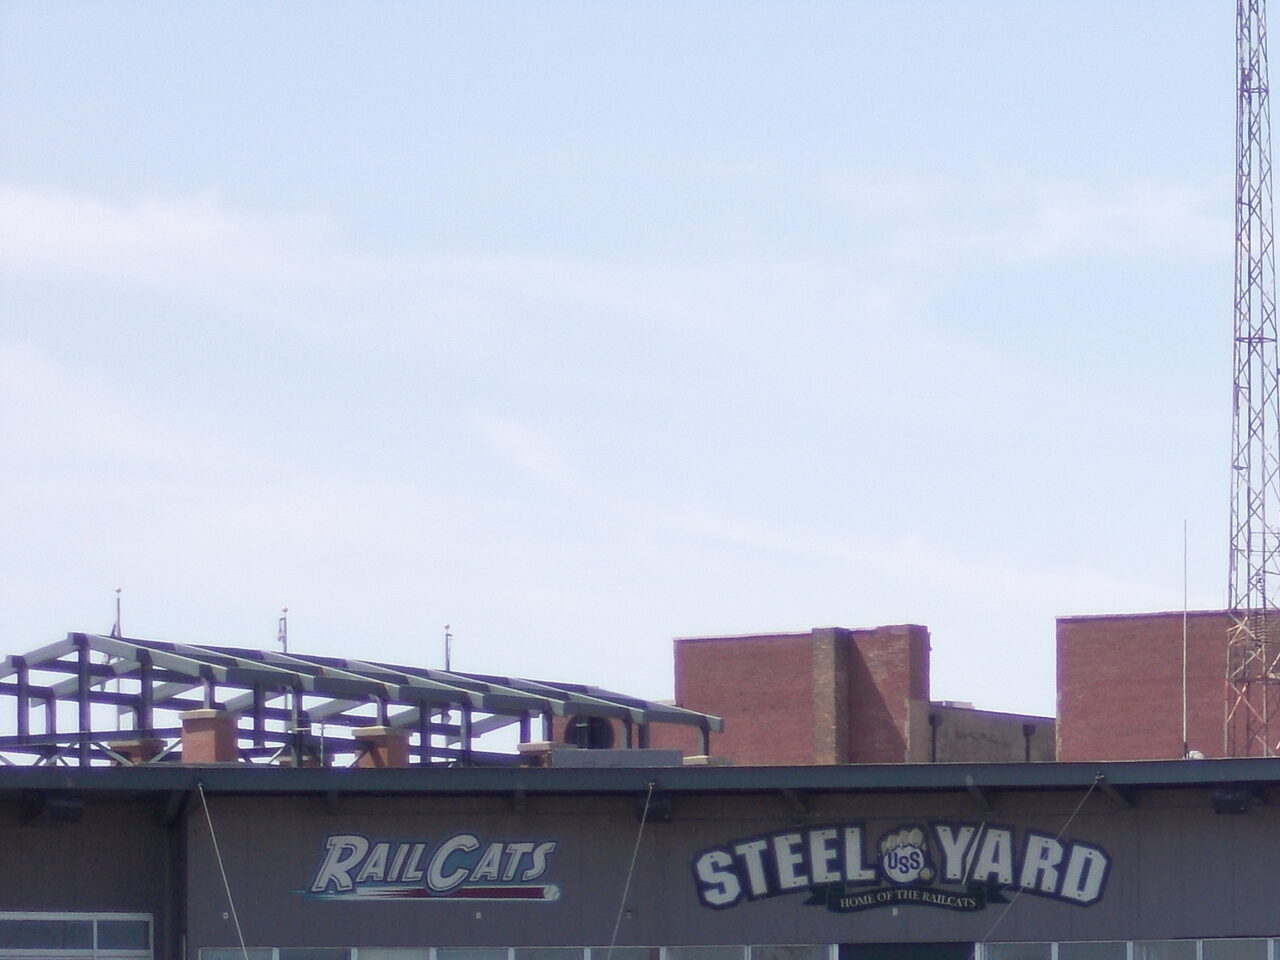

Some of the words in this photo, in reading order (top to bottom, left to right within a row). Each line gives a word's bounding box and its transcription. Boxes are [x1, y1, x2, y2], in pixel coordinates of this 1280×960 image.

[696, 827, 878, 906] STEEL
[935, 824, 1107, 903] YARD
[887, 850, 921, 874] USS
[840, 892, 875, 908] HOME
[877, 891, 893, 902] OF
[895, 890, 920, 901] THE
[921, 891, 977, 909] RAILCATS
